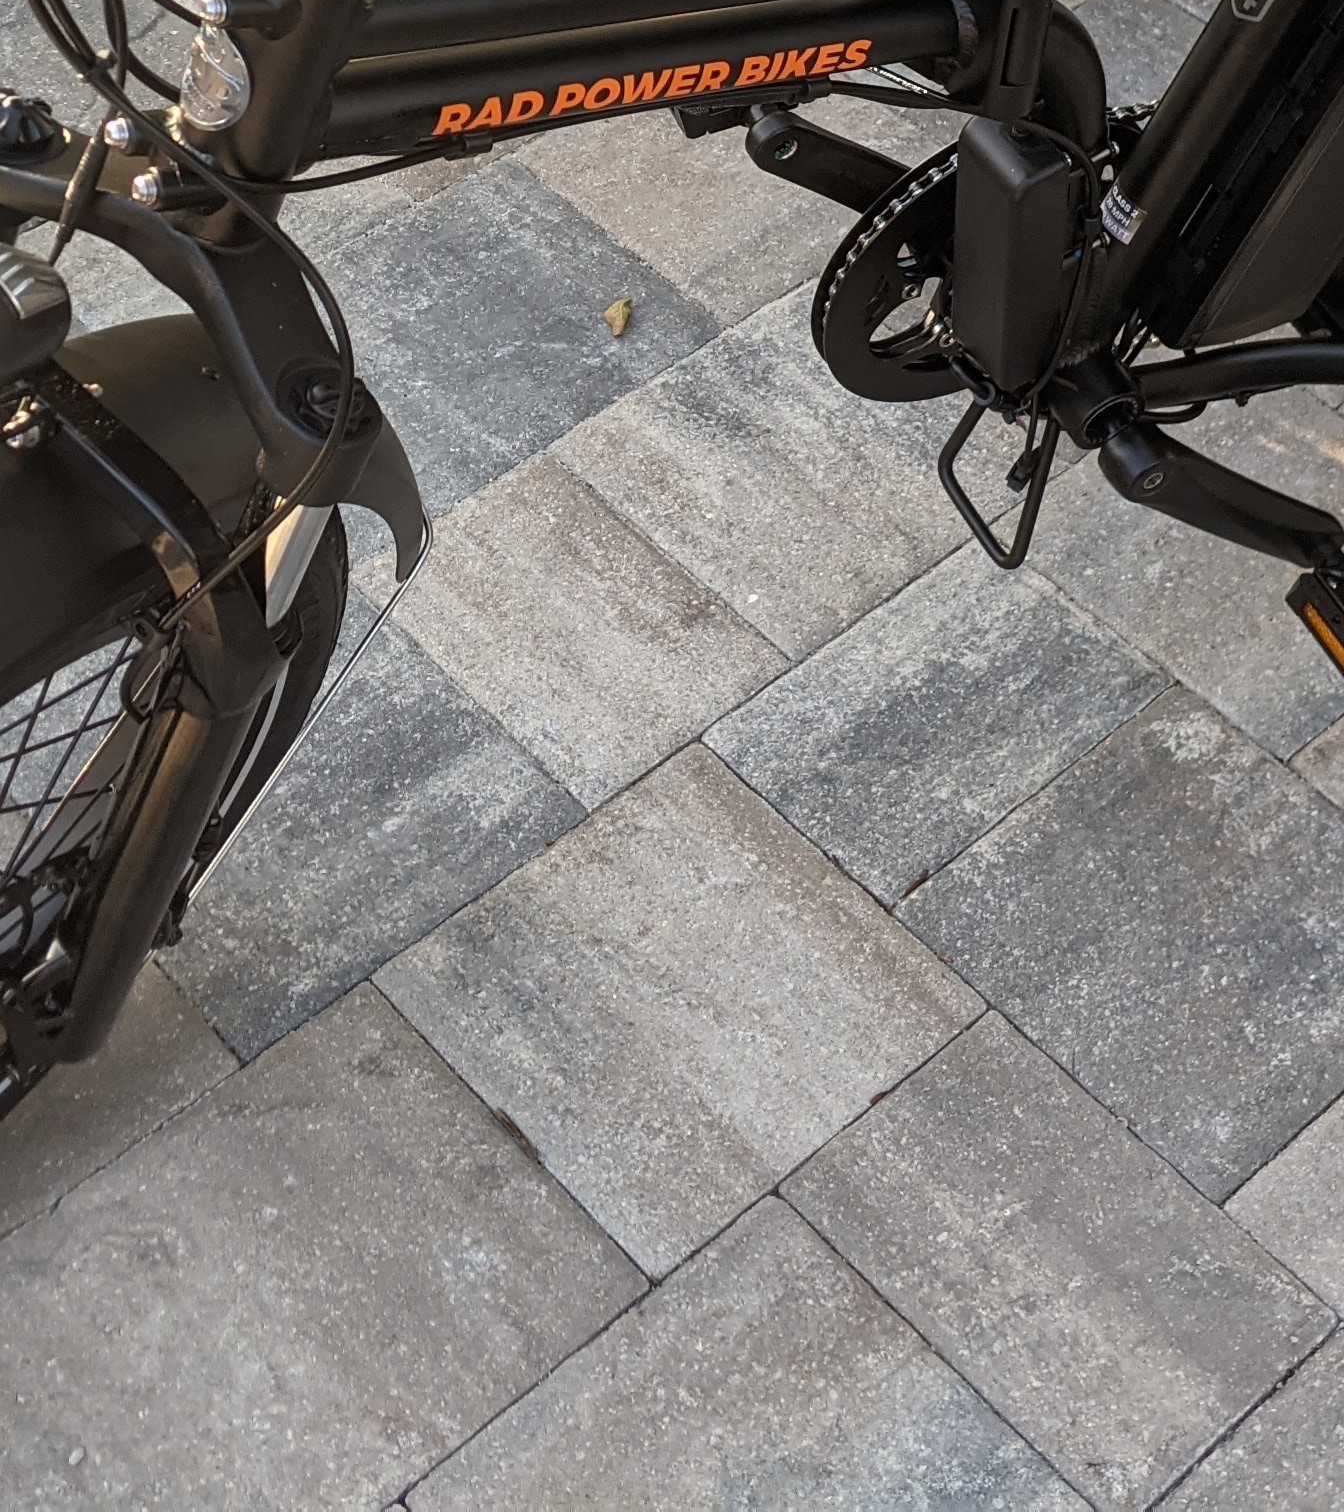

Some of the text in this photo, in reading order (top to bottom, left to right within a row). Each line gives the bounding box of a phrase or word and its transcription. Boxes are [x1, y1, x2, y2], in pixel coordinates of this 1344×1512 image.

[432, 90, 545, 136] RAD
[549, 60, 731, 117] POWER
[733, 38, 873, 88] BIKES
[1111, 206, 1131, 228] MPH
